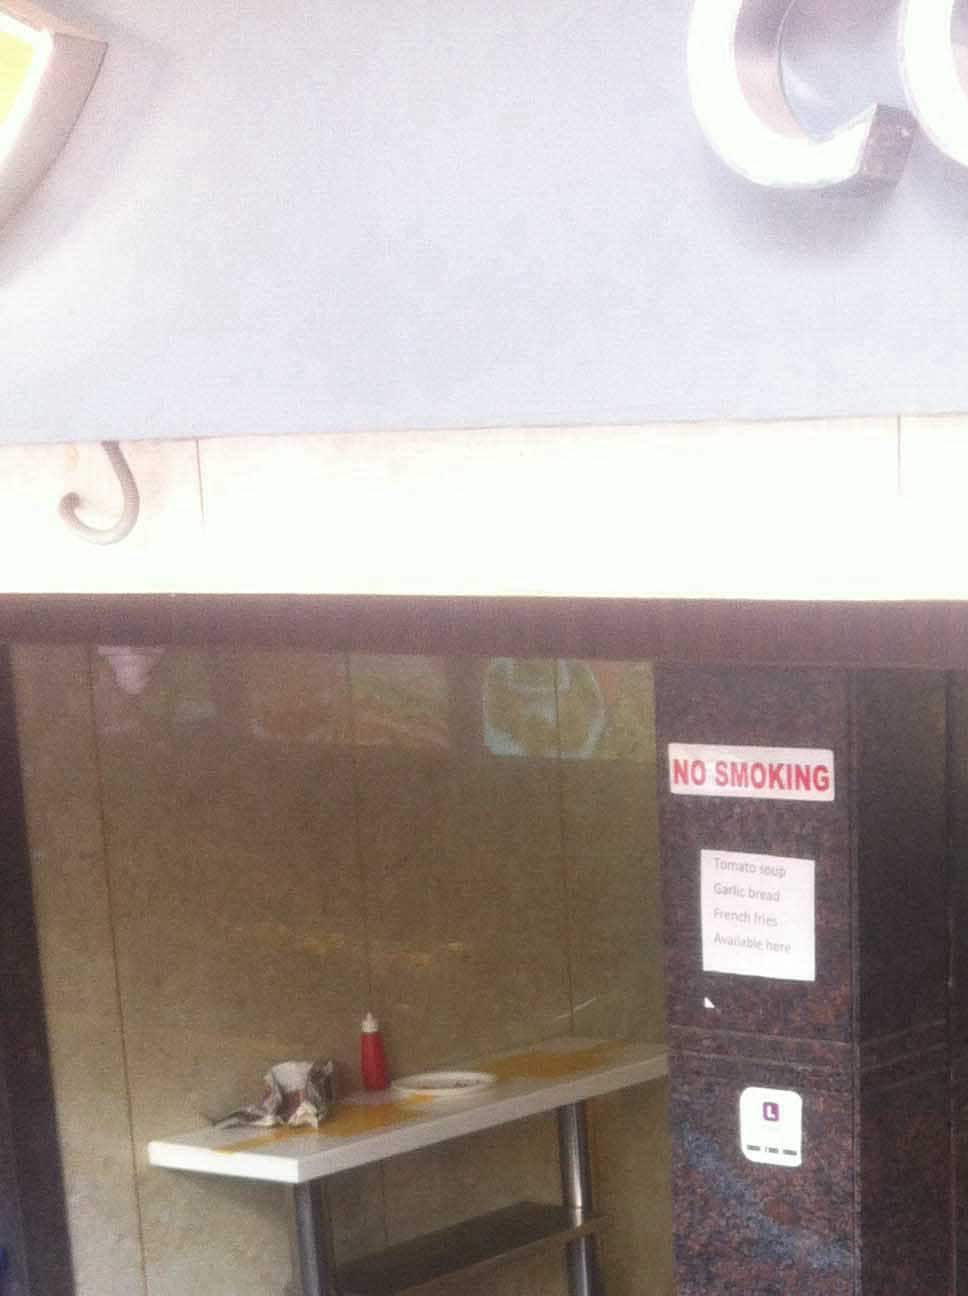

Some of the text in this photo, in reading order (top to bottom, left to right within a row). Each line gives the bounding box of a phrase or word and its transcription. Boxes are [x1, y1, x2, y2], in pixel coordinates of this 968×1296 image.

[673, 758, 830, 792] NO SMOKING
[713, 857, 786, 879] Tomato soup
[713, 882, 781, 902] Garlic bread
[713, 907, 778, 927] French fries
[714, 932, 792, 954] Available here
